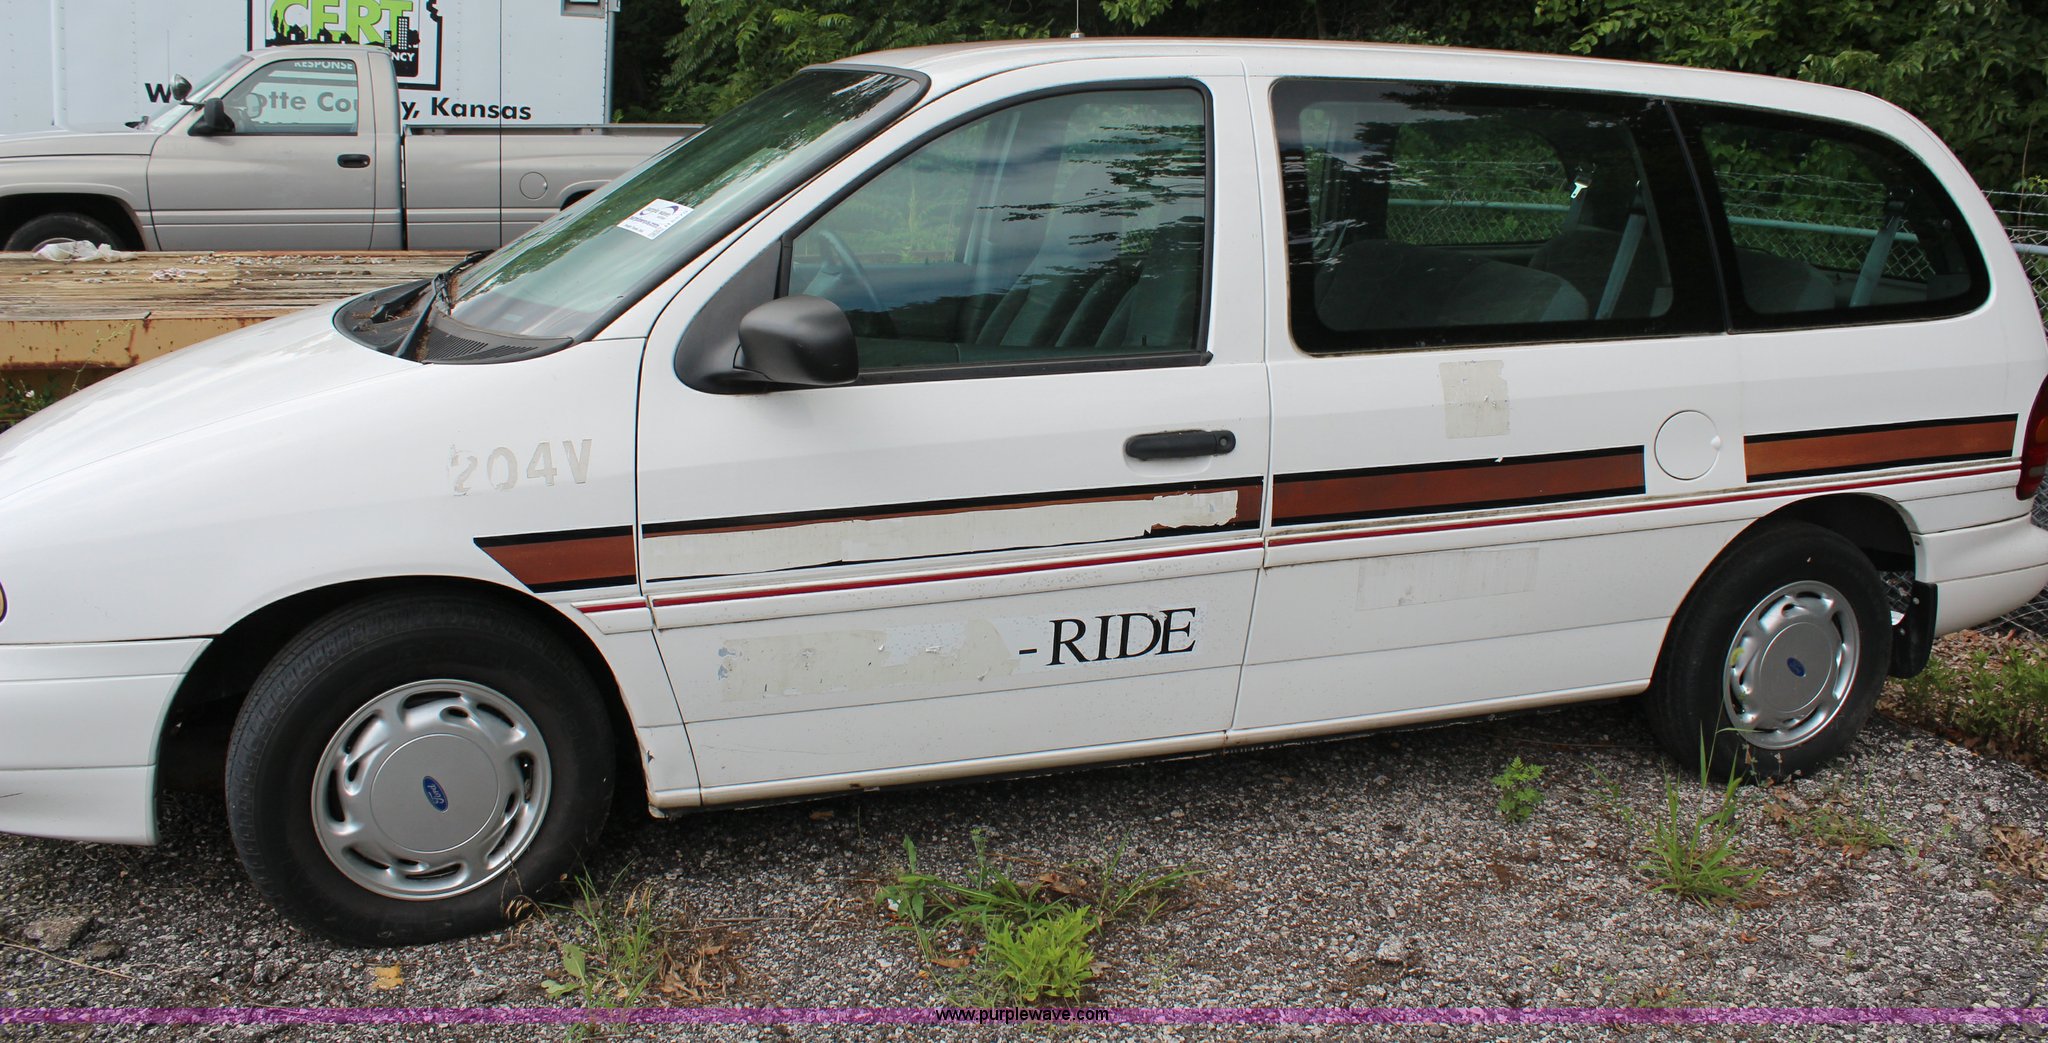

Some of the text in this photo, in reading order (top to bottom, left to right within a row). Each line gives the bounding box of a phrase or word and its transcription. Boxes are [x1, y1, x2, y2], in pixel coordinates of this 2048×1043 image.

[270, 0, 413, 45] CERT
[431, 97, 532, 120] Kansas
[449, 439, 592, 496] 204V
